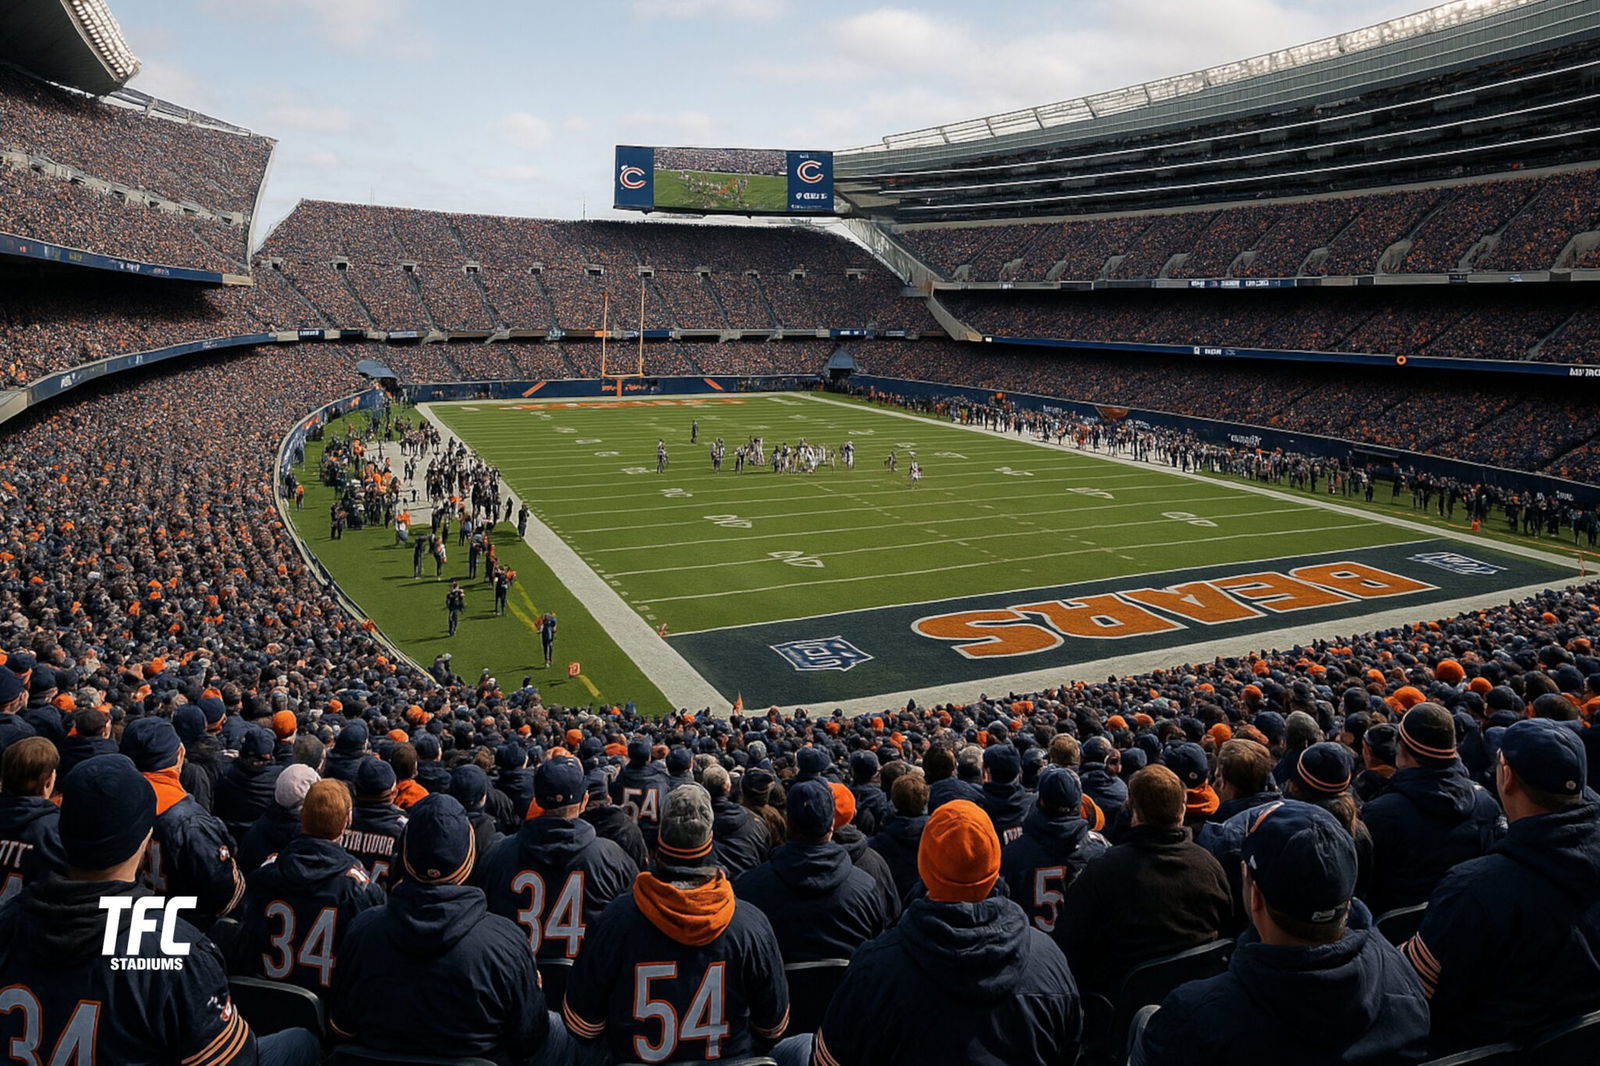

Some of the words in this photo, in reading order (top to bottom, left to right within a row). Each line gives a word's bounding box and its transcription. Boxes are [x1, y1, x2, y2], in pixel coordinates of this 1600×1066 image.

[620, 167, 646, 188] C
[797, 160, 824, 183] C
[911, 561, 1440, 659] BEARS
[623, 787, 659, 825] 54
[262, 900, 338, 987] 34
[511, 869, 586, 958] 34
[632, 960, 730, 1064] 54
